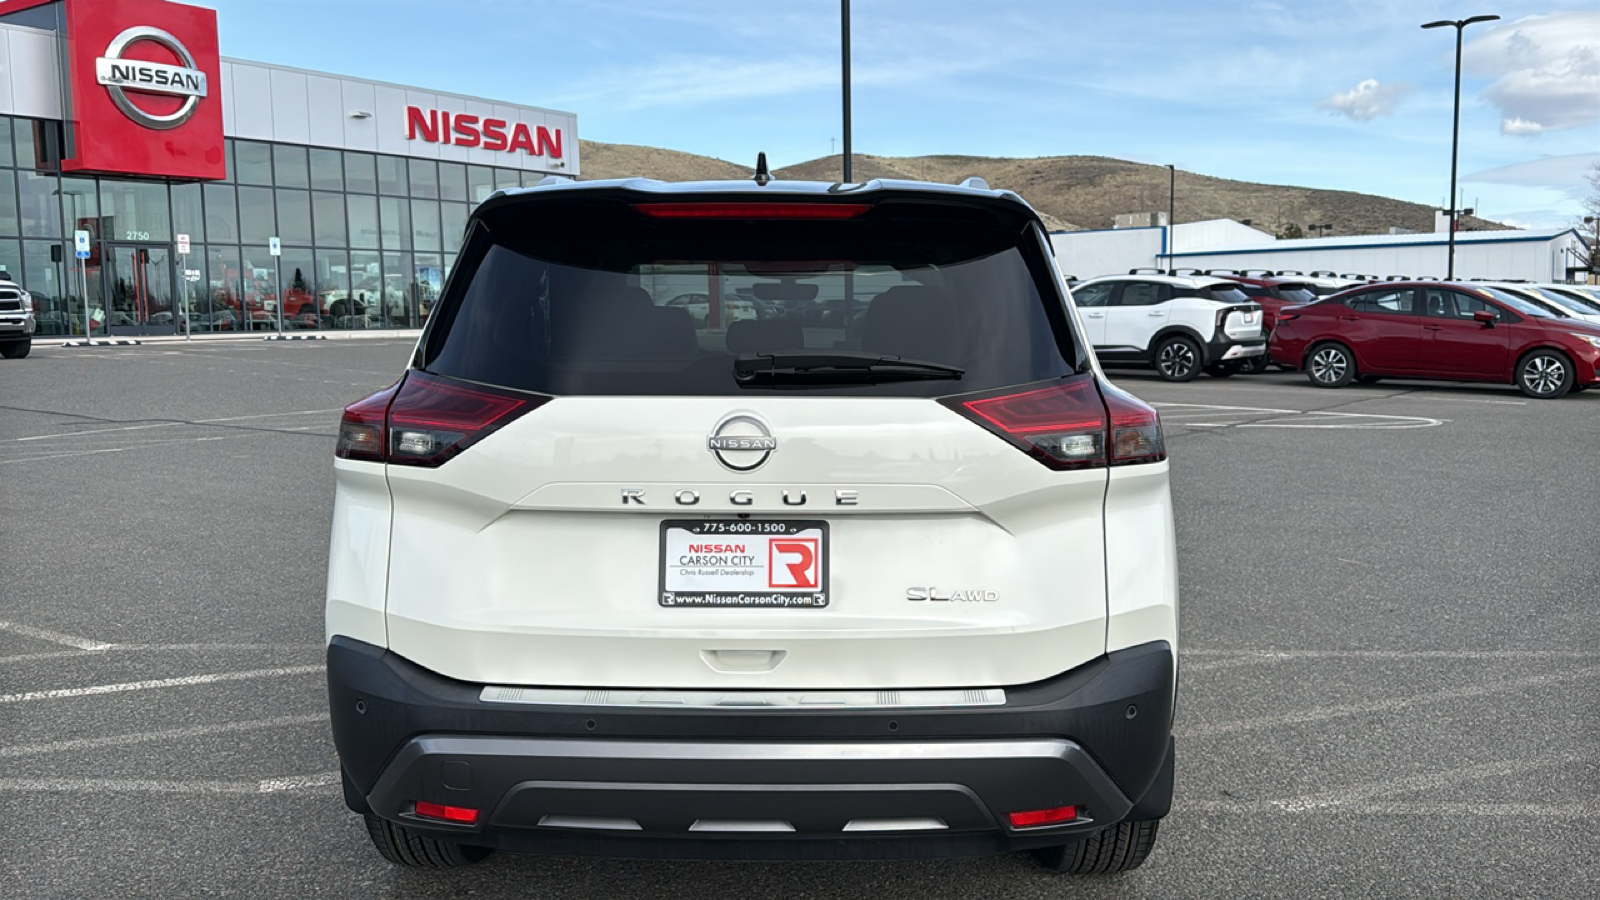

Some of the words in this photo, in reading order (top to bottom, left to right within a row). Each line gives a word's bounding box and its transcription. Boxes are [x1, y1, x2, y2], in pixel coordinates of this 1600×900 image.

[111, 64, 200, 91] NISSAN
[406, 105, 563, 159] NISSAN
[126, 231, 150, 240] 2750
[710, 438, 776, 449] NISSAN
[621, 488, 859, 506] ROGUE
[703, 523, 786, 533] 775-600-1500
[688, 544, 746, 553] NISSAN
[679, 555, 728, 566] CARSON
[730, 555, 755, 566] CITY
[679, 568, 696, 576] Chris
[698, 568, 719, 576] Russell
[720, 568, 755, 577] Dealership
[675, 593, 812, 606] www.NissanCarsonCity.com
